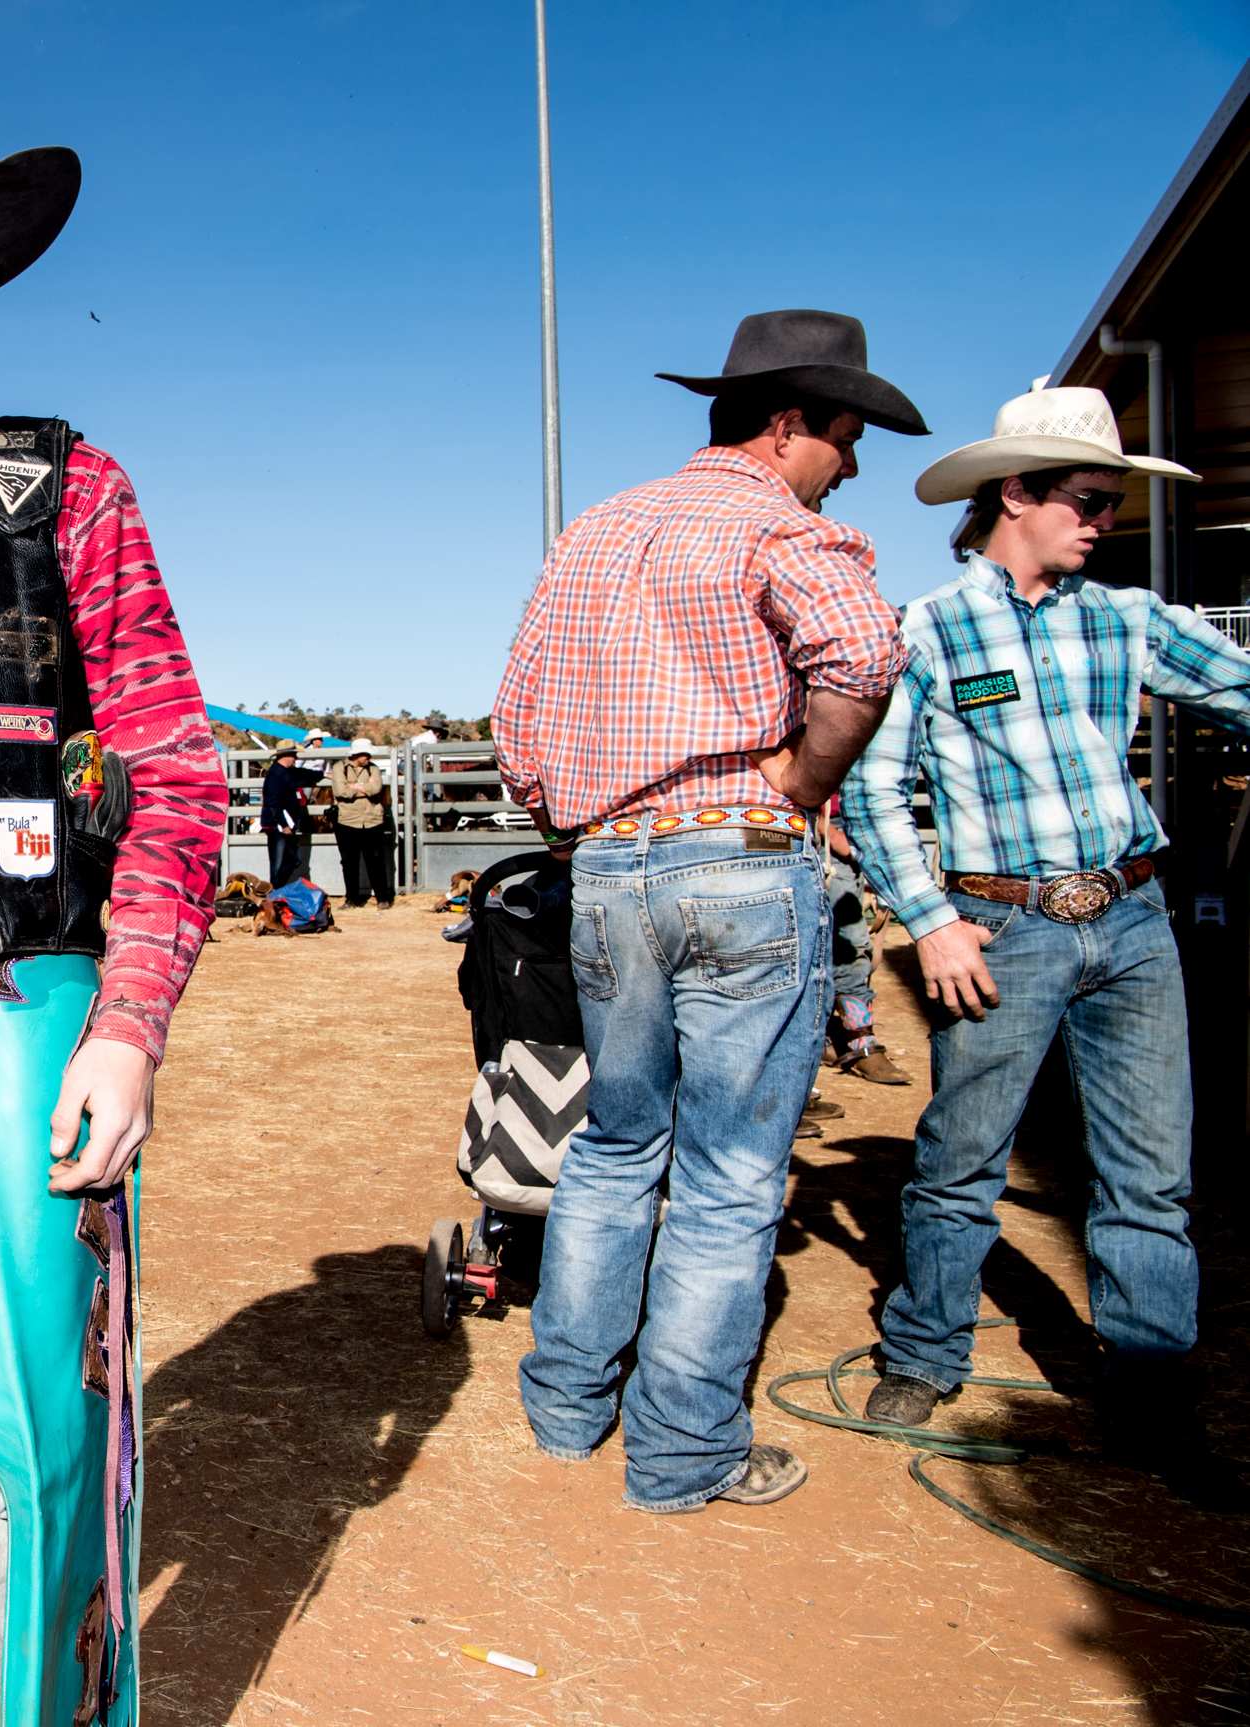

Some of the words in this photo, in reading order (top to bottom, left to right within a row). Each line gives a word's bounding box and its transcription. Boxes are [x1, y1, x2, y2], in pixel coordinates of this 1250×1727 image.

[956, 675, 1013, 692] PARKSIDE
[957, 683, 1015, 701] PRODUCE
[14, 829, 52, 861] Fiji
